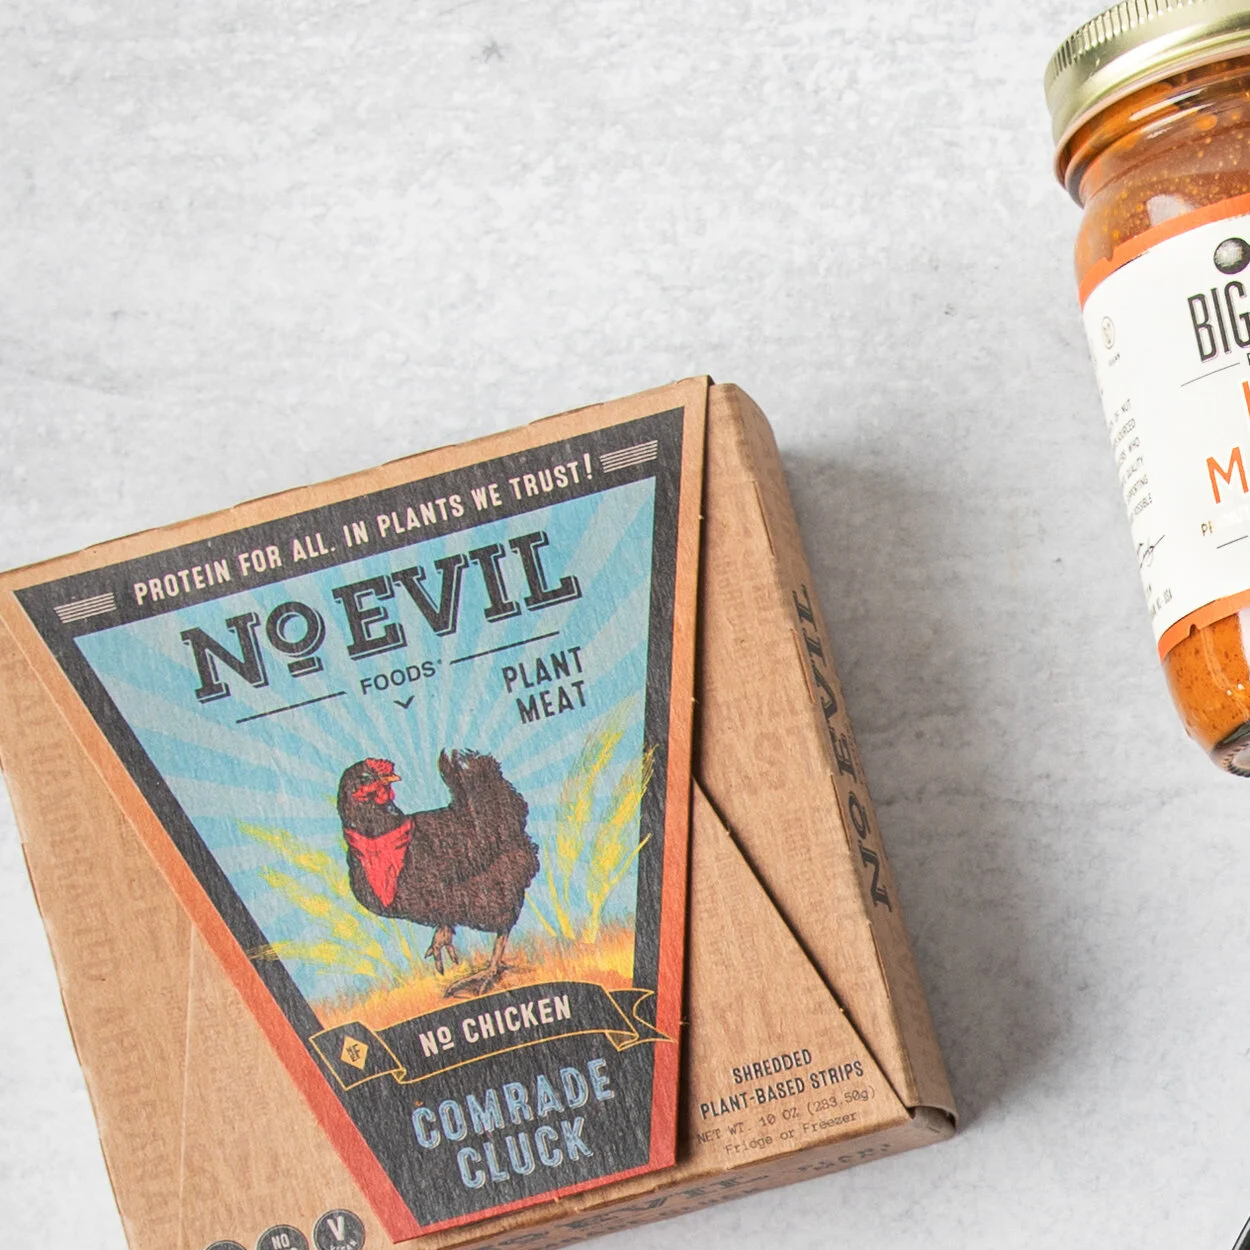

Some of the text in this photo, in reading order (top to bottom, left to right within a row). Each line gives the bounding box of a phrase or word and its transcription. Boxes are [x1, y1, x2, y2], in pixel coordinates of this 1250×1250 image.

[134, 453, 593, 605] PROTEIN FOR ALL. IN PLANTS WE TRUST!
[332, 531, 582, 661] EVIL
[360, 661, 437, 695] FOODS
[502, 646, 585, 693] PLANT
[515, 681, 588, 724] MEAT
[462, 995, 571, 1045] CHICKEN
[700, 1060, 864, 1120] PLANT-BASED STRIPS
[732, 1049, 812, 1084] SHREDDED
[411, 1058, 615, 1150] COMRADE
[696, 1127, 721, 1145] NET
[728, 1122, 751, 1137] WT.
[758, 1114, 776, 1128] 10
[806, 1087, 876, 1115] (283.50g)
[457, 1116, 595, 1189] CLUCK
[726, 1111, 858, 1155] Fridge or Freezer
[271, 1233, 290, 1250] NO
[327, 1216, 346, 1241] V
